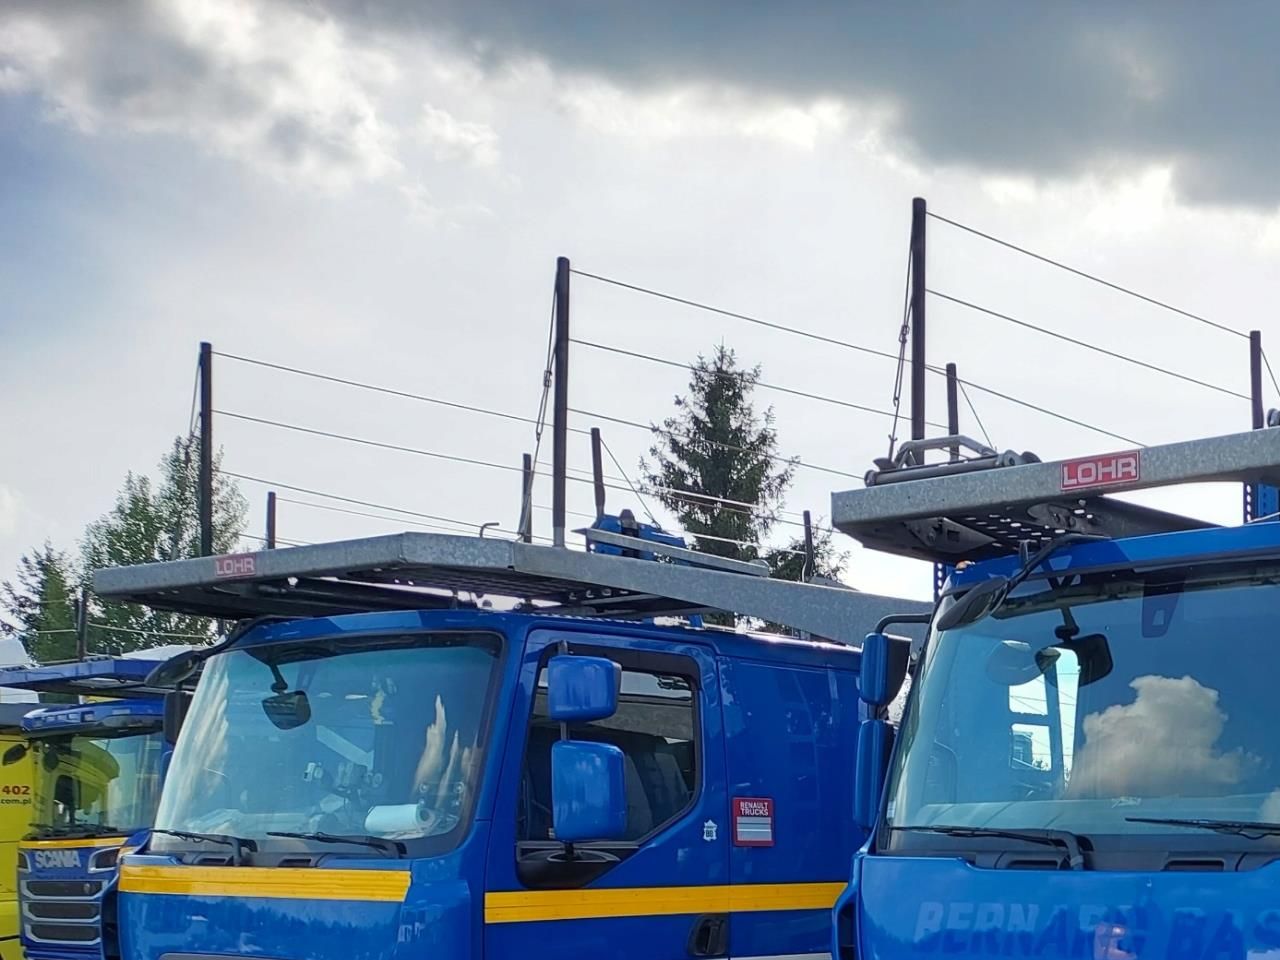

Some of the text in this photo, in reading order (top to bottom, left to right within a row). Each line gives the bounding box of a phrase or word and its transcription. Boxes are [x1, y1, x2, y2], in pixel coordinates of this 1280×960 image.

[1063, 457, 1137, 486] LOHR
[215, 557, 254, 575] LOHR
[2, 785, 31, 796] 402
[740, 801, 769, 809] RENAULT
[740, 807, 769, 816] TRUCKS
[35, 850, 81, 868] SCANIA
